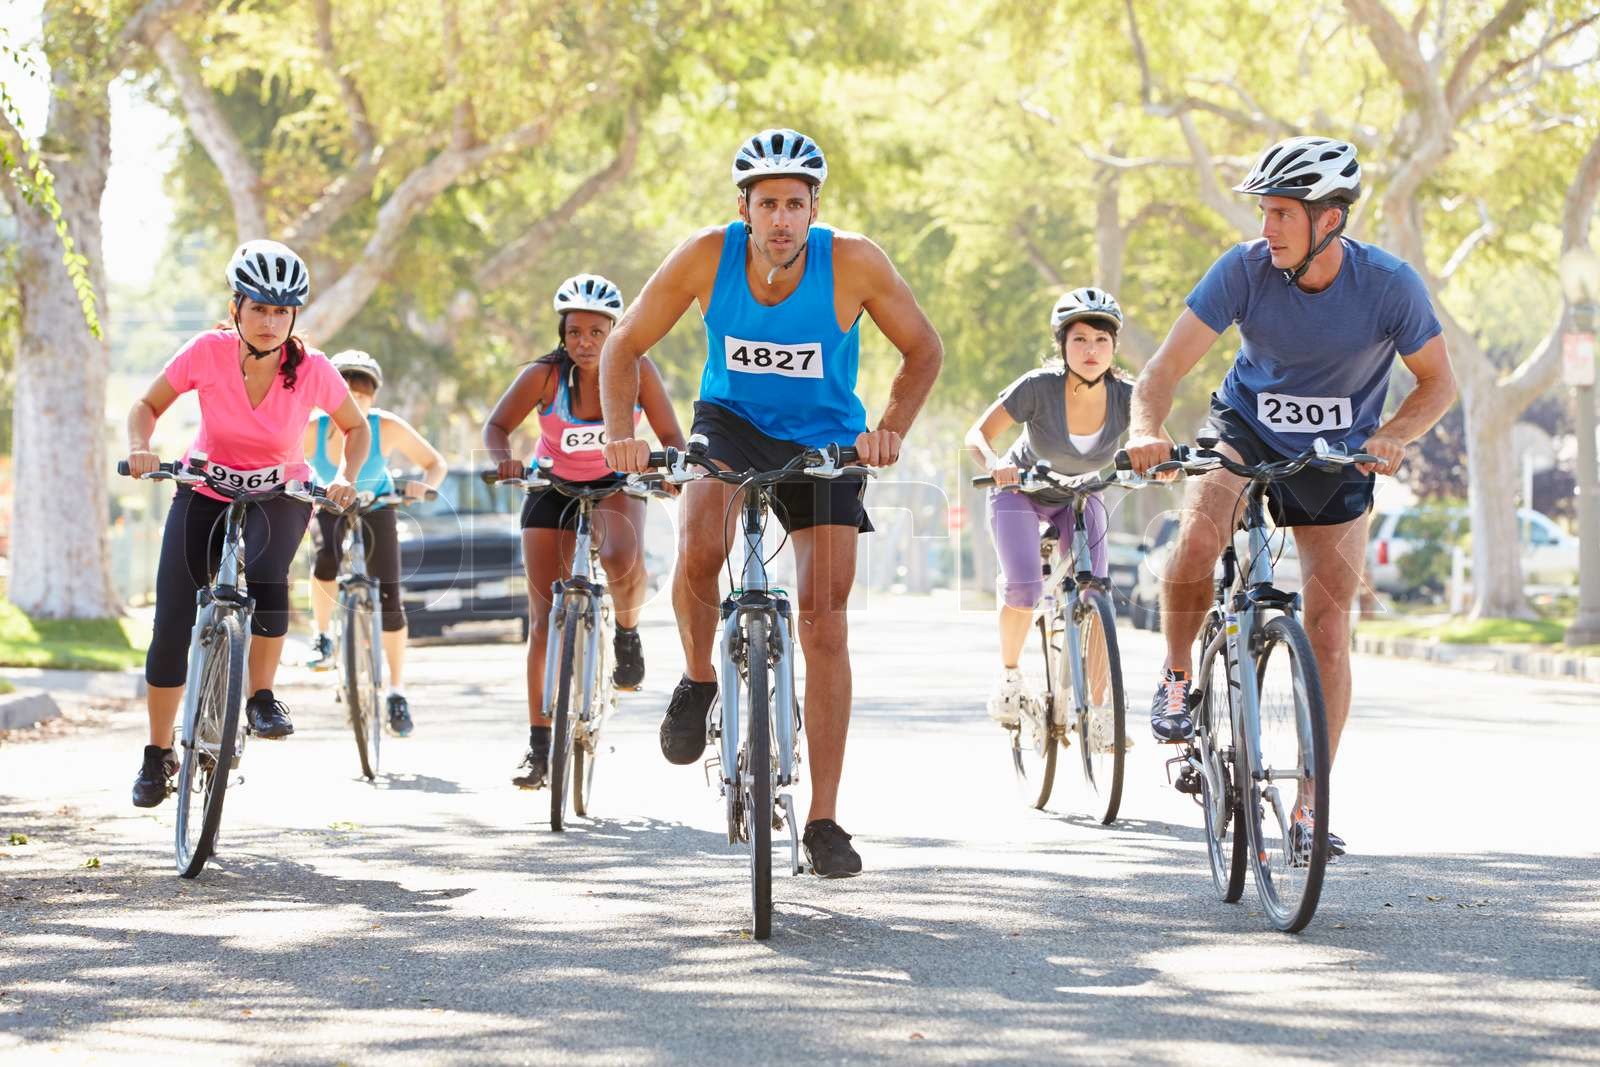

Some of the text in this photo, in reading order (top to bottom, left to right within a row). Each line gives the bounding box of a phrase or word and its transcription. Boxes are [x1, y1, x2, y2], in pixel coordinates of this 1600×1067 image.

[731, 345, 816, 371] 4827
[1263, 397, 1342, 427] 2301
[211, 465, 280, 489] 9964
